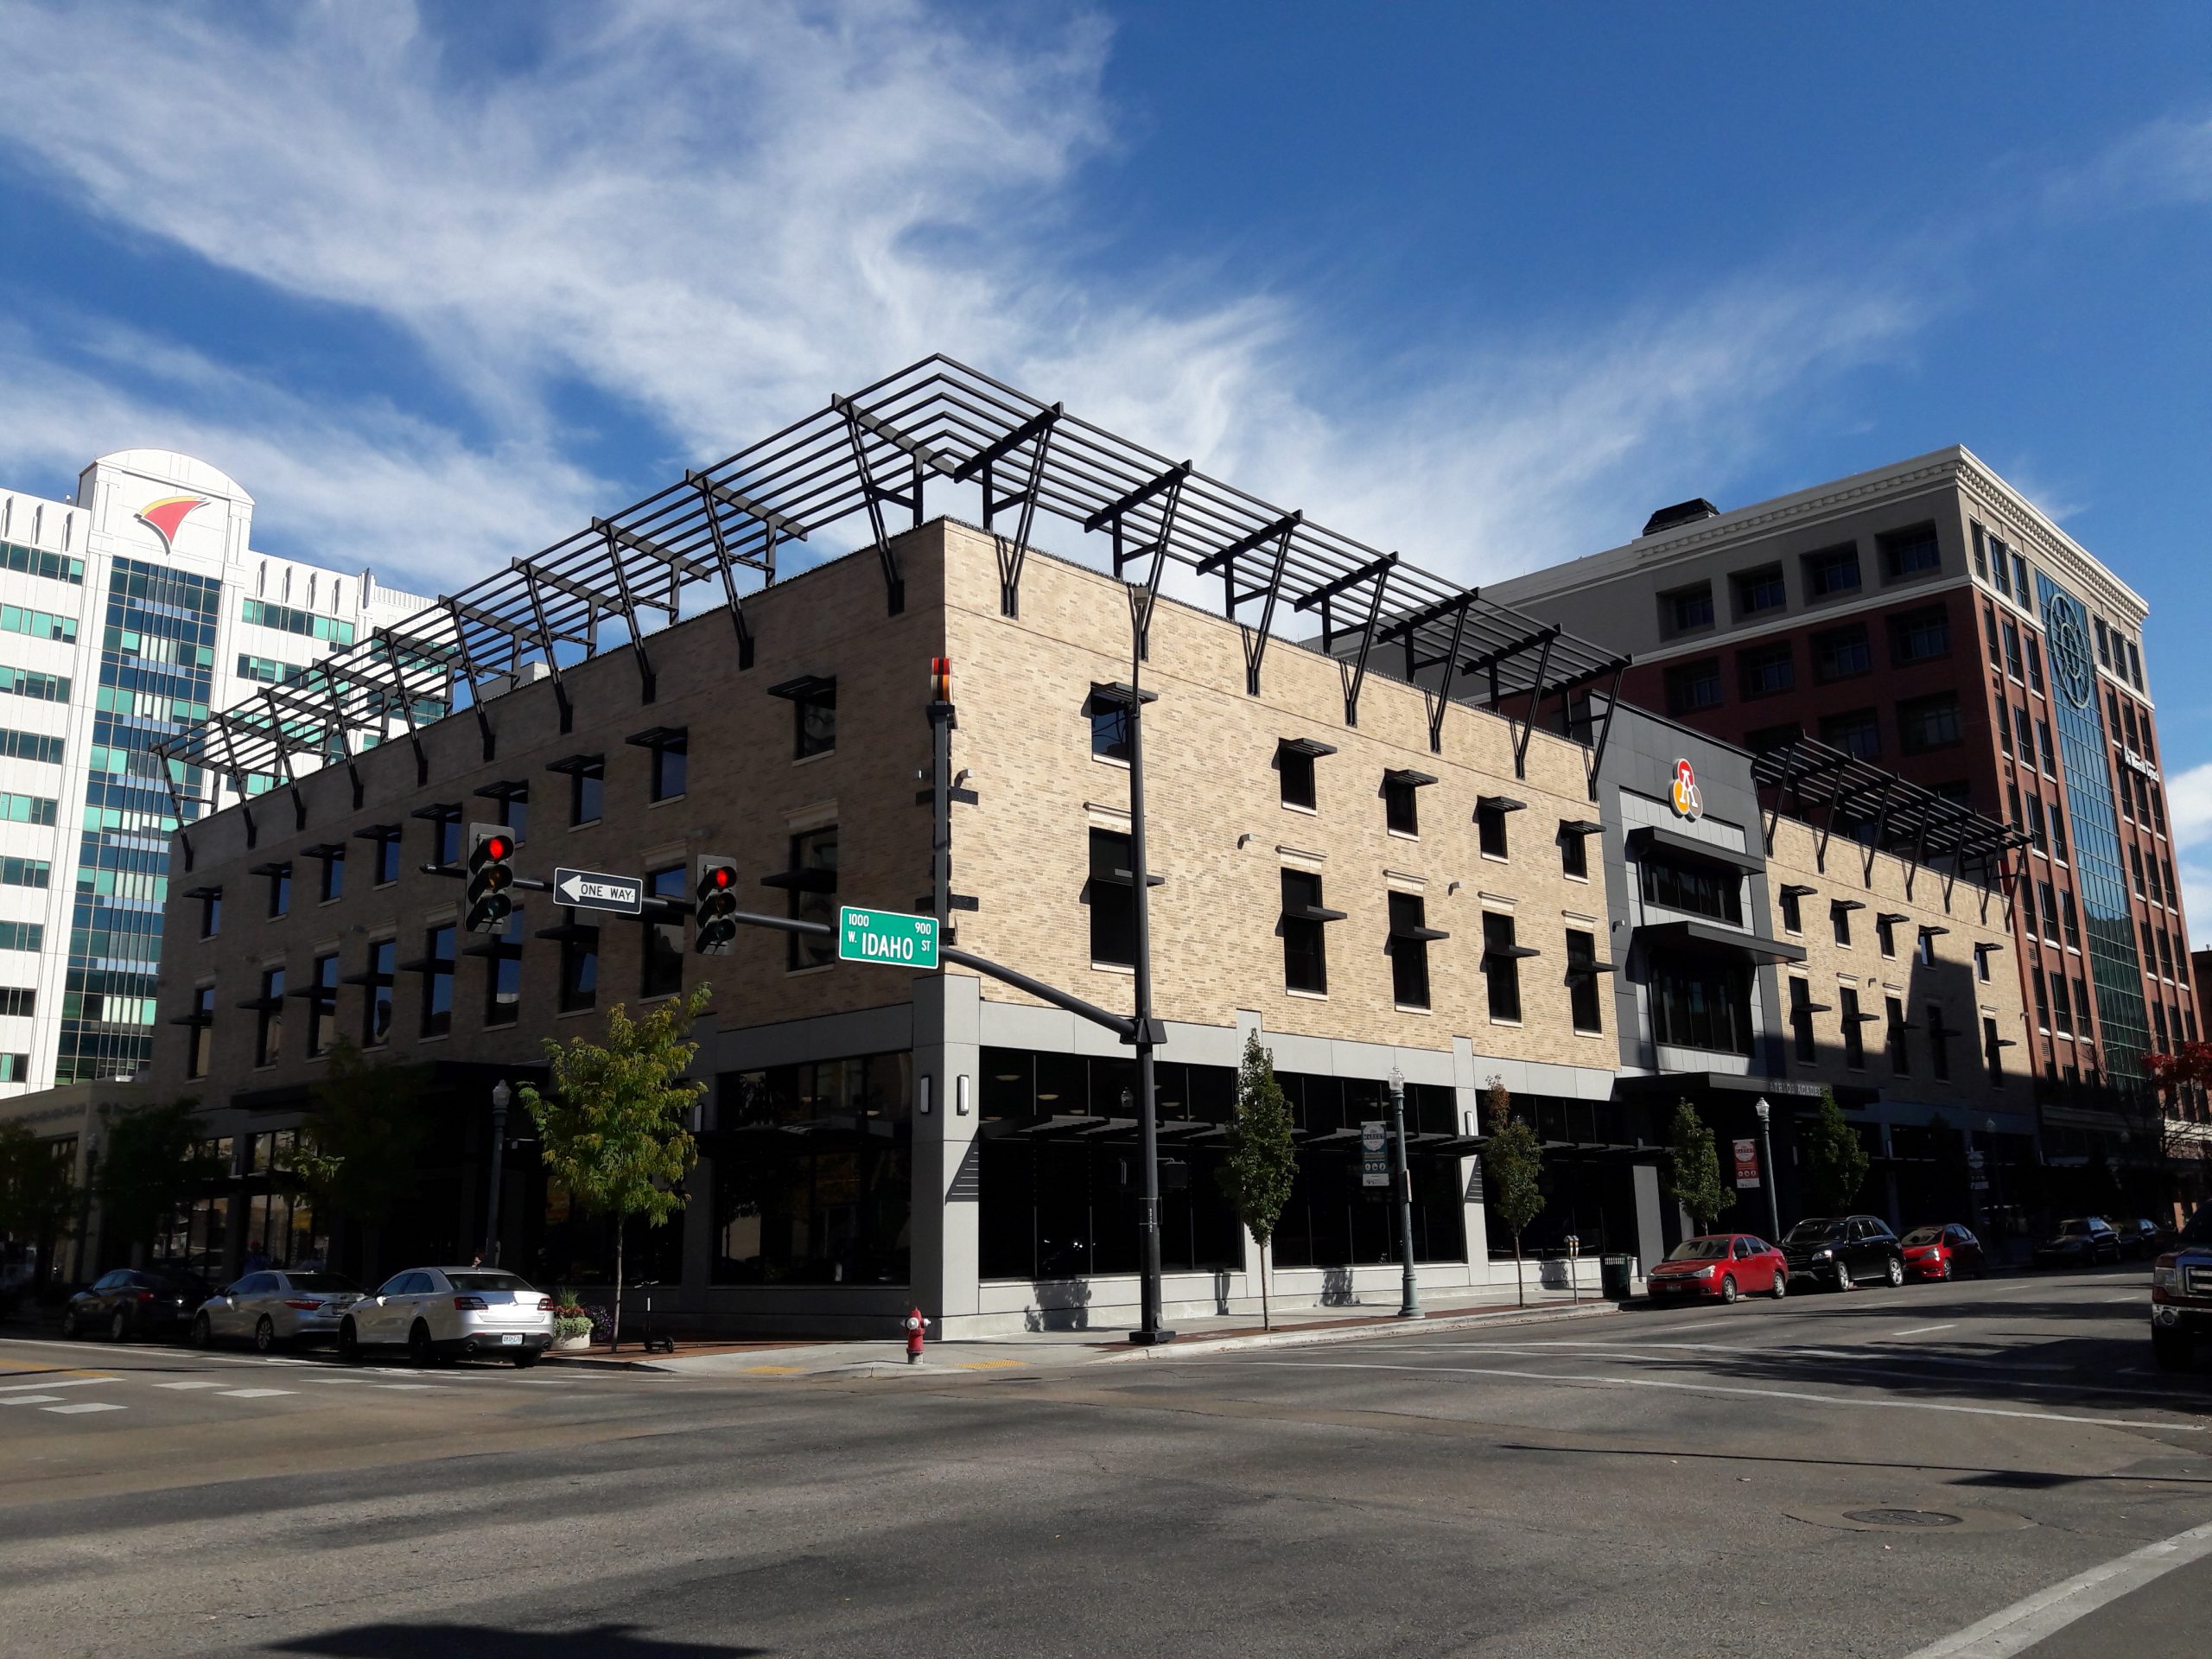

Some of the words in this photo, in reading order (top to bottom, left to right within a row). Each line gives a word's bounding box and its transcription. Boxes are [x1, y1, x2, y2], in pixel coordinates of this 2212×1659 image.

[581, 883, 603, 897] ONE
[610, 887, 632, 900] WAY
[849, 913, 869, 927] 1000
[914, 922, 931, 935] 900
[848, 931, 857, 943] W.
[862, 932, 913, 960] IDAHO
[921, 940, 931, 951] ST
